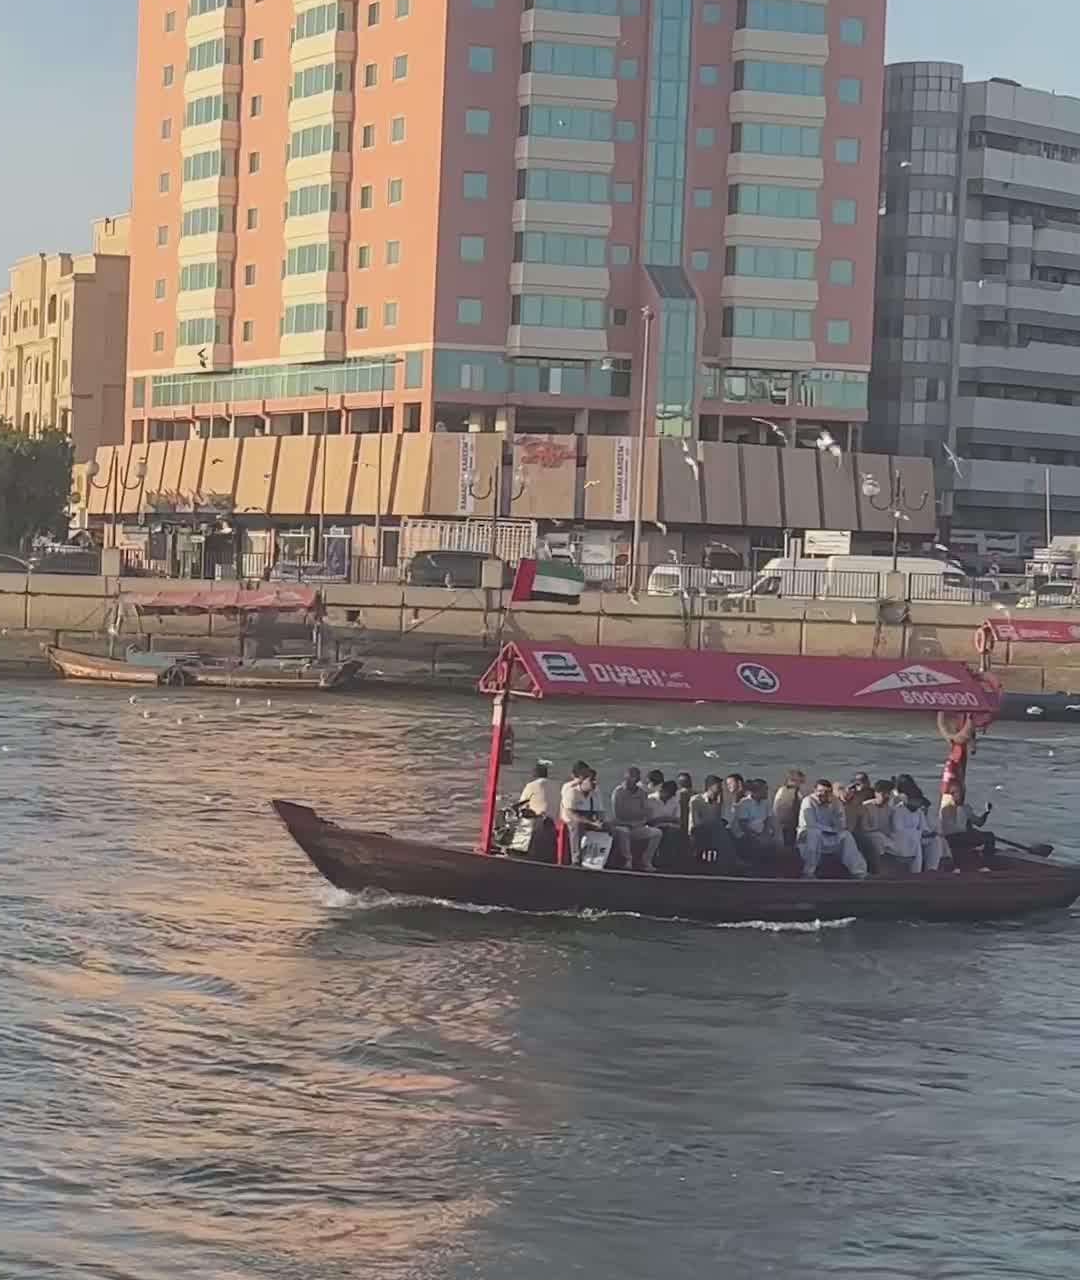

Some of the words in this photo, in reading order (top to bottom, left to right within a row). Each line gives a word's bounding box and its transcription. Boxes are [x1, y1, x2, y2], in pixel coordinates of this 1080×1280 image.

[589, 663, 664, 688] DUBAI
[742, 668, 774, 687] 14
[895, 671, 940, 684] RTA
